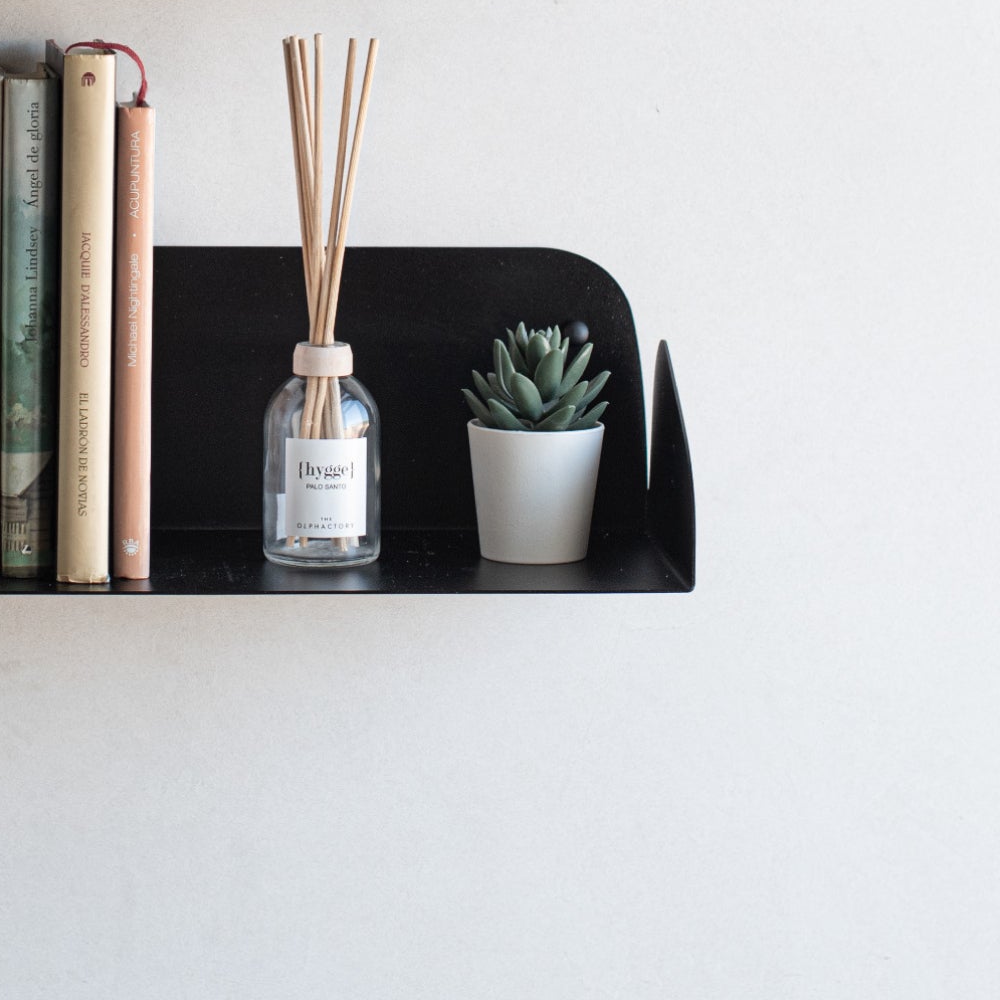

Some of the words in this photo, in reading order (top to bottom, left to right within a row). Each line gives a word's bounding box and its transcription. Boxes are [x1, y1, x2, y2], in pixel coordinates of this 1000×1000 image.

[129, 130, 141, 219] ACUPUNTURA
[128, 253, 140, 318] Nightingale
[127, 322, 137, 367] Michael
